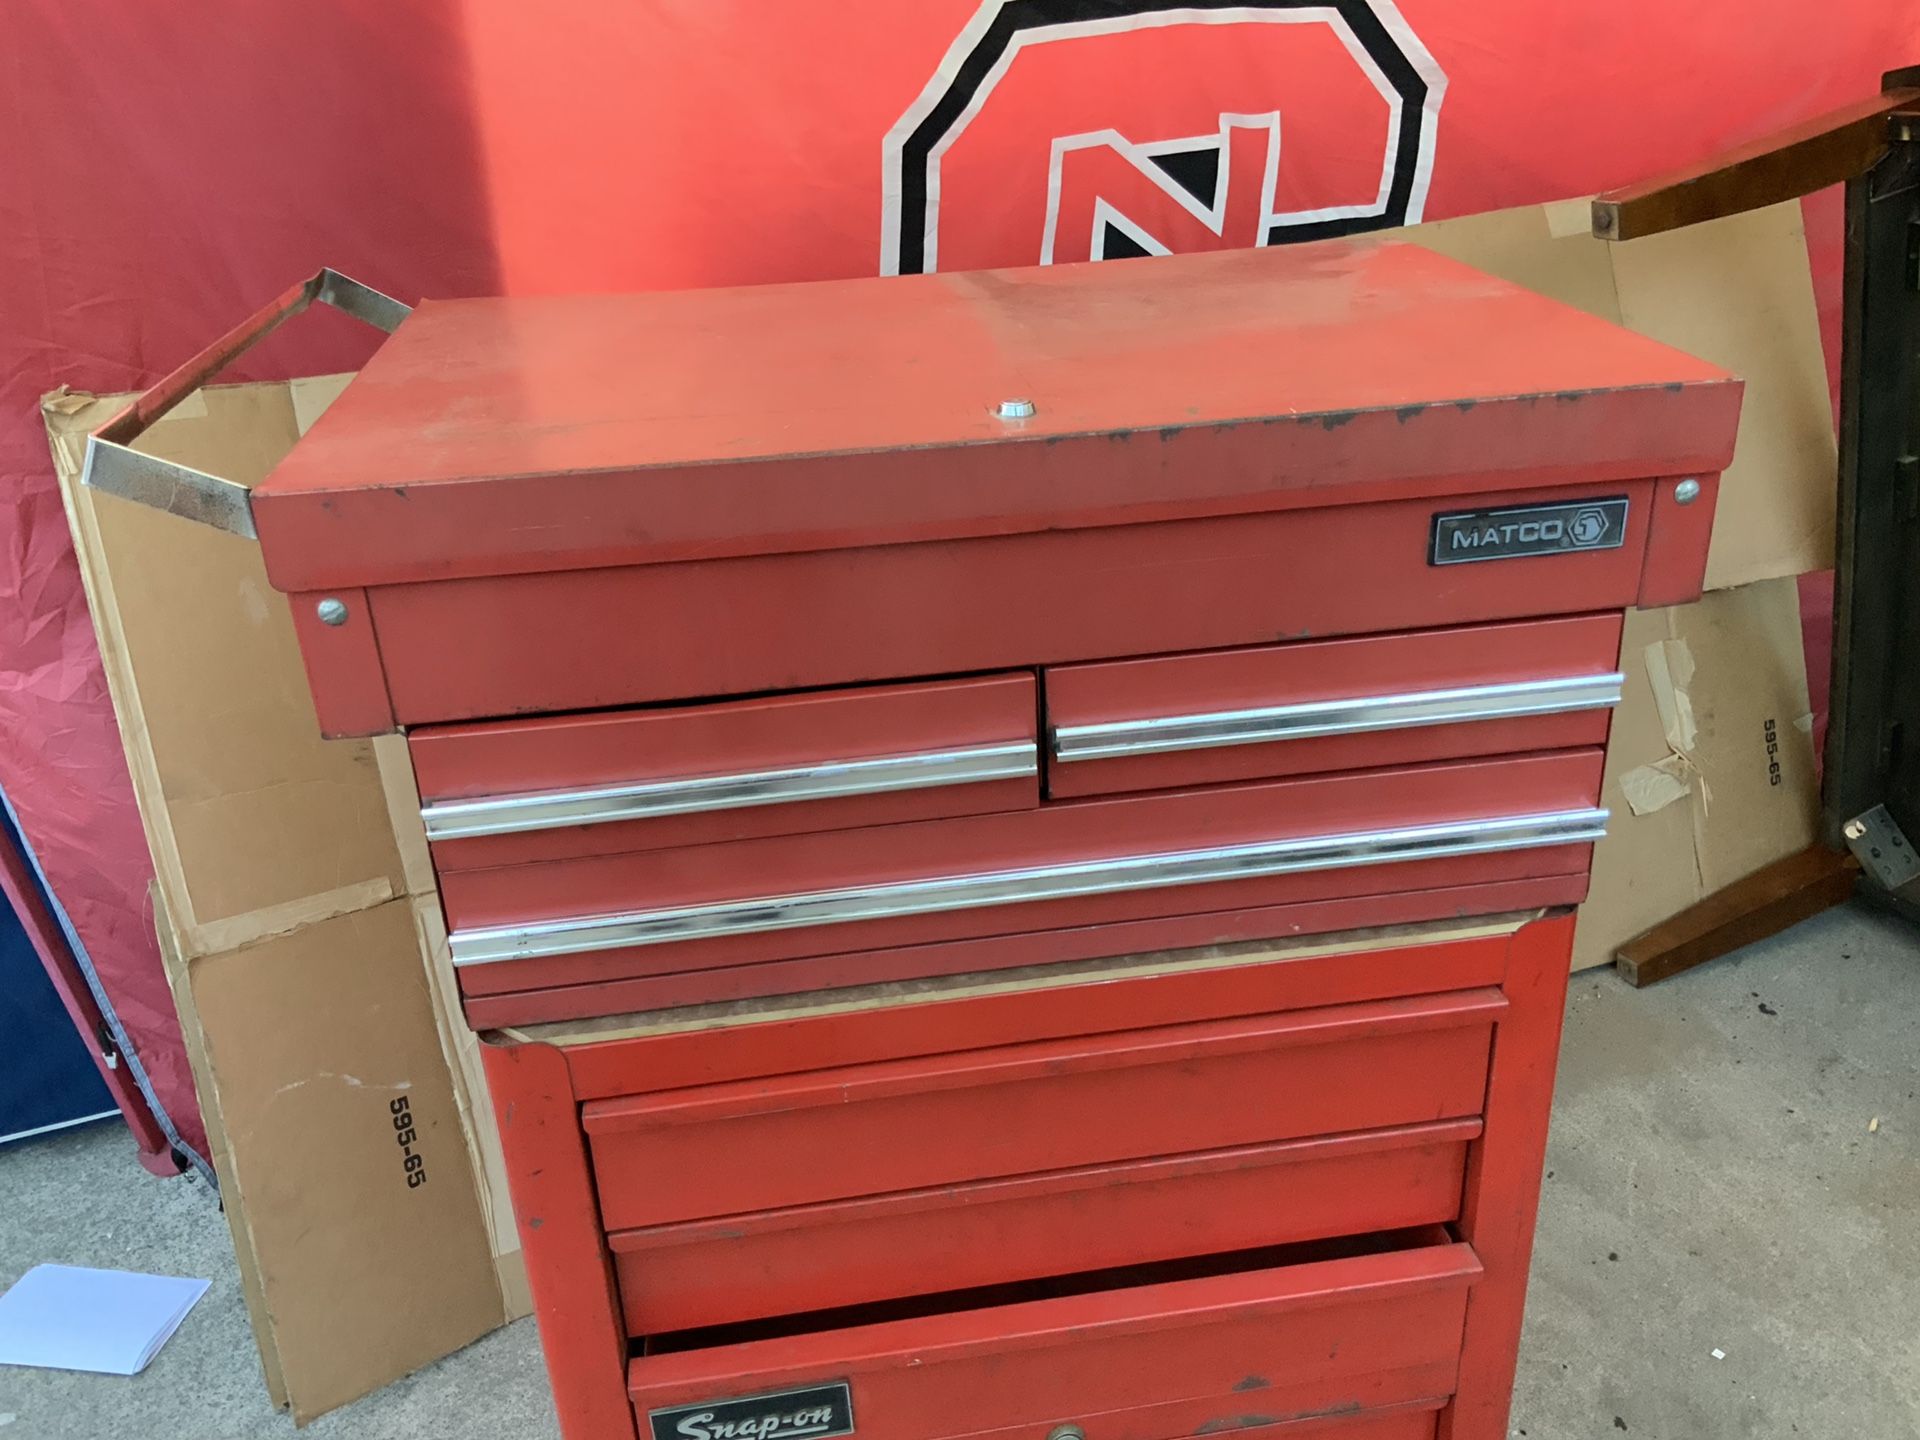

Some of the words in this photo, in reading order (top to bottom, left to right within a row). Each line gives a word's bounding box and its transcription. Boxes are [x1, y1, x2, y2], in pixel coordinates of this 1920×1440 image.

[1452, 520, 1564, 549] MATCO
[1764, 719, 1781, 786] 595-65
[390, 1096, 427, 1188] 595-65
[676, 1404, 833, 1440] Snap-on
